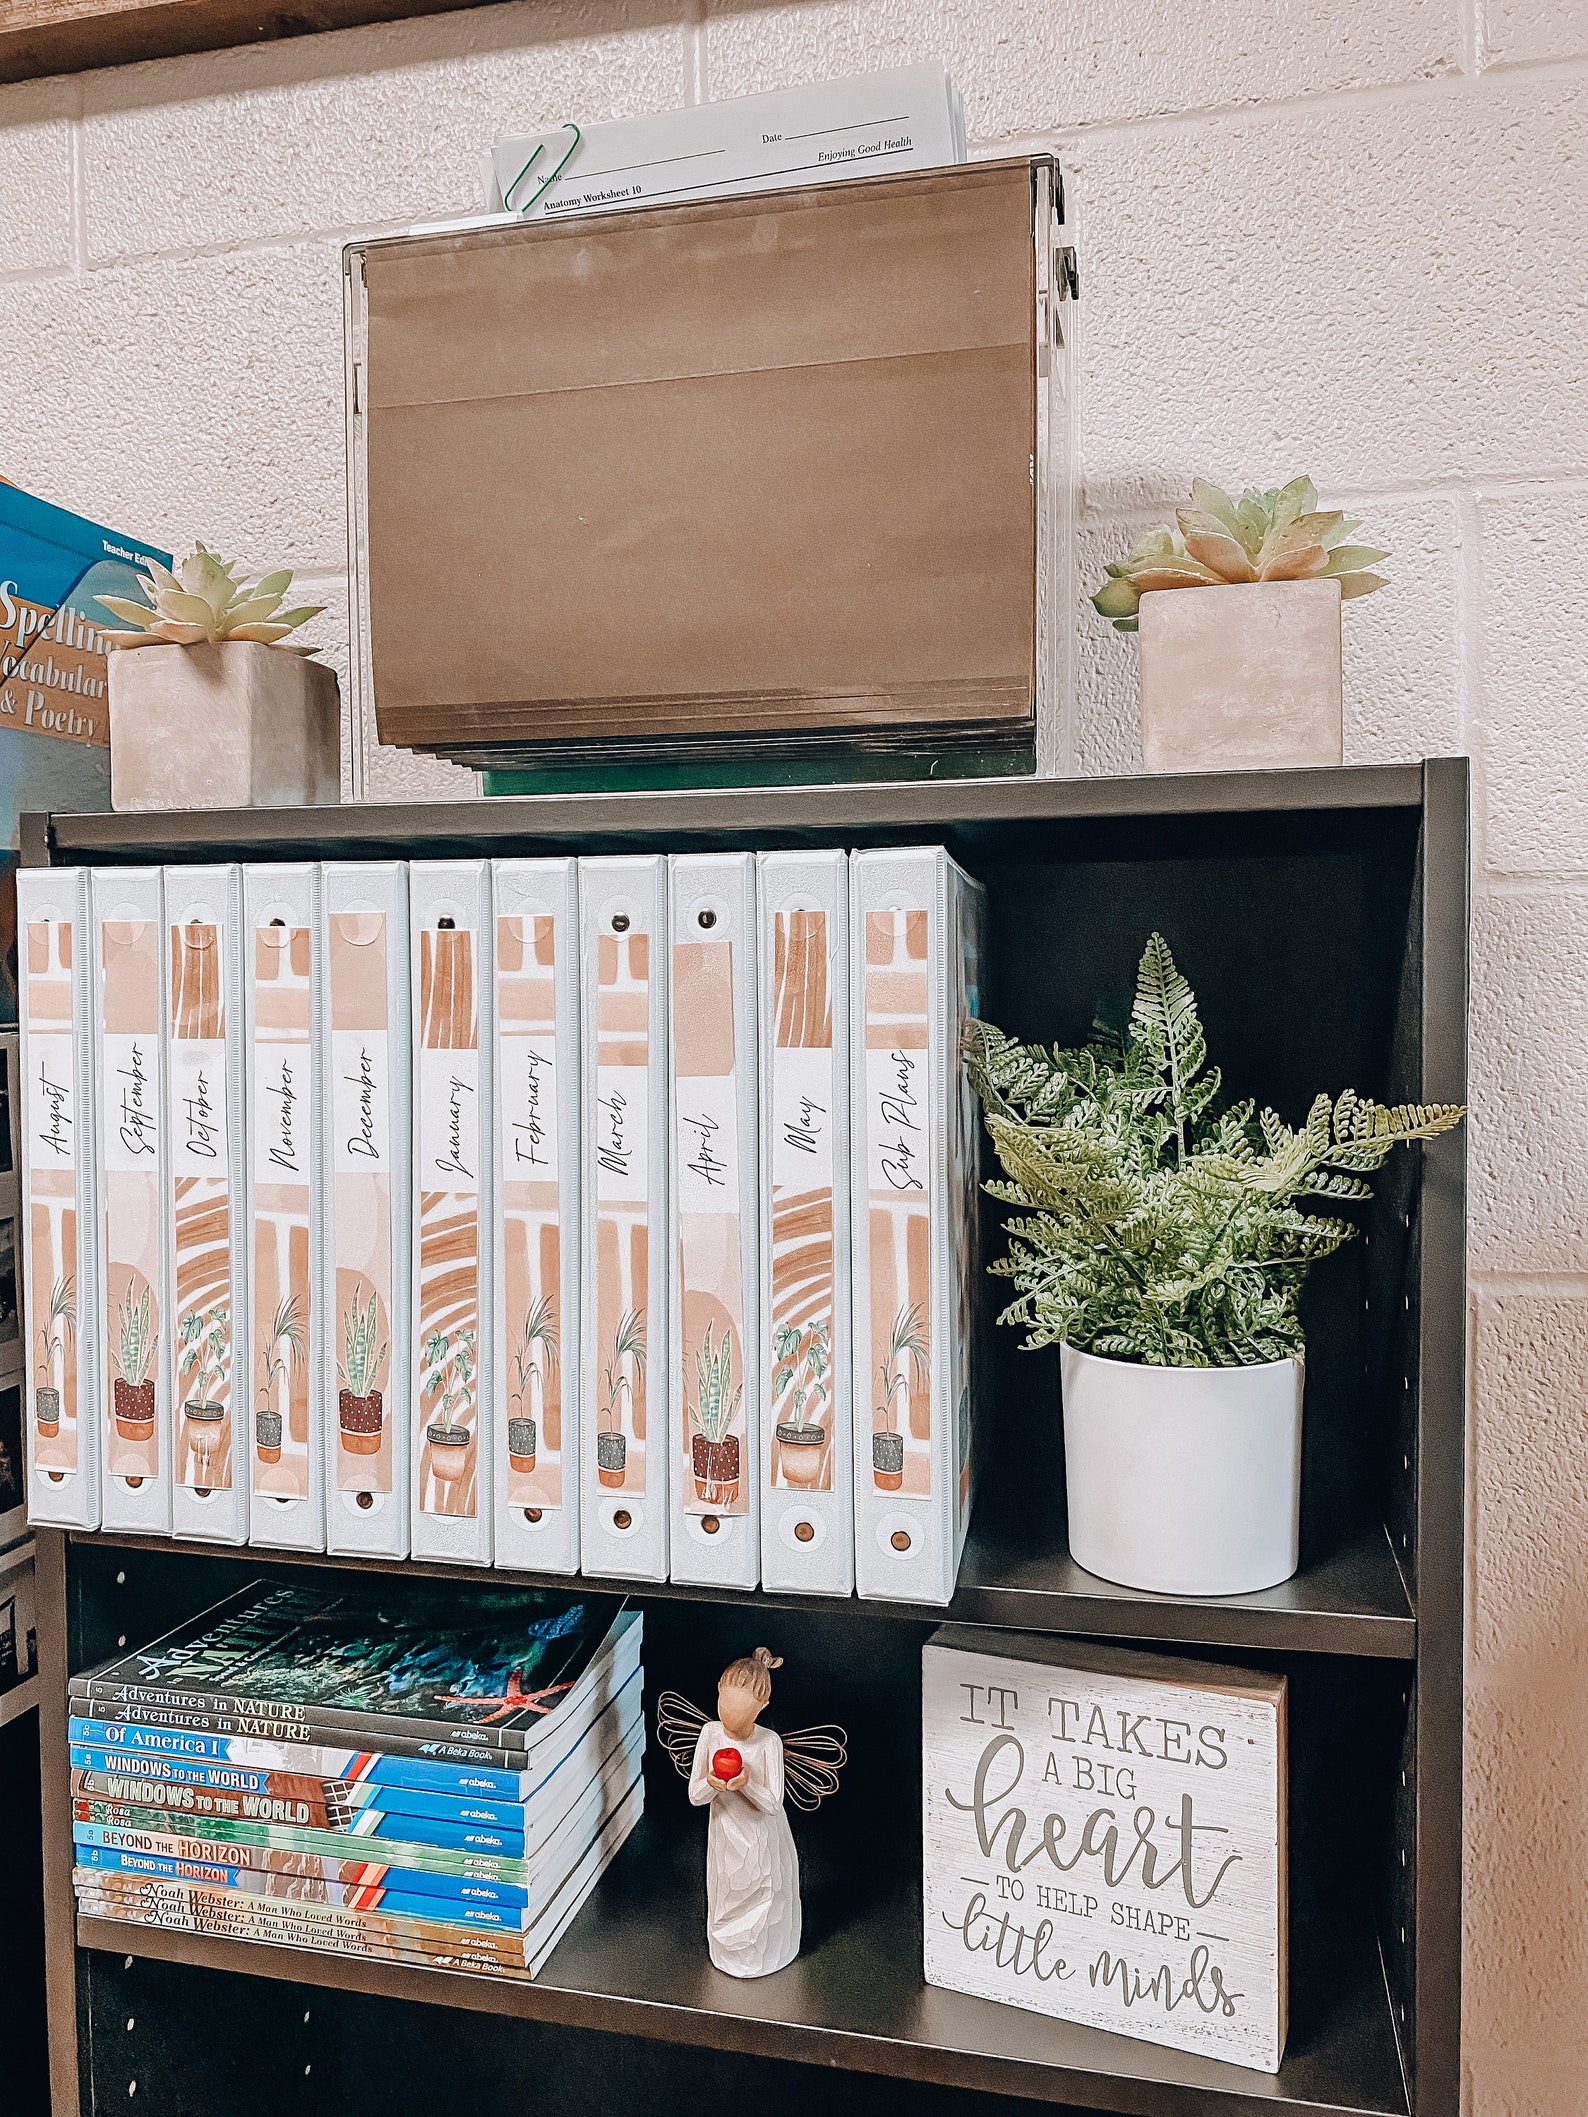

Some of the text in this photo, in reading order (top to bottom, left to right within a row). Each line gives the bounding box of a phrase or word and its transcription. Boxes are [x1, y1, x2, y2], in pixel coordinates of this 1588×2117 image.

[762, 132, 783, 144] Date
[817, 136, 912, 162] Enjoying Good Health
[544, 184, 642, 211] Anatomy Worksheet 10
[102, 539, 134, 561] Teacher
[0, 689, 16, 714] &
[39, 1061, 72, 1155] August
[117, 1041, 156, 1155] September
[183, 1070, 219, 1157] October
[266, 1058, 300, 1172] November
[344, 1047, 379, 1159] December
[512, 1050, 553, 1164] February
[879, 1050, 923, 1189] Sub Plans
[435, 1075, 474, 1178] January
[598, 1089, 632, 1175] March
[782, 1095, 827, 1153] May
[682, 1113, 728, 1185] April
[137, 1590, 294, 1680] Adventures
[112, 1685, 306, 1721] Adventures in NATURE
[115, 1705, 311, 1741] Adventures in NATURE
[105, 1727, 218, 1755] Of America I
[960, 1683, 1228, 1769] IT TAKES
[105, 1755, 259, 1790] WINDOWS TO THE WORLD
[447, 1748, 468, 1757] Beka
[1041, 1752, 1137, 1800] A BIG
[105, 1803, 131, 1816] Rosa
[106, 1815, 132, 1828] Rosa
[107, 1778, 309, 1824] WINDOWS TO THE WORLD
[945, 1734, 1243, 1908] heart
[103, 1831, 251, 1866] BEYOND THE HORIZON
[157, 1864, 173, 1873] THE
[176, 1862, 229, 1883] HORIZON
[140, 1883, 367, 1928] Noah Webster: A Man Who Loved Words
[140, 1897, 367, 1942] Noah Webster: A Man Who Loved Words
[996, 1875, 1190, 1941] TO HELP SHAPE
[144, 1911, 373, 1953] Noah Webster: A Man Who Loved Words
[942, 1892, 1245, 2017] little minds
[461, 1960, 480, 1969] Beka
